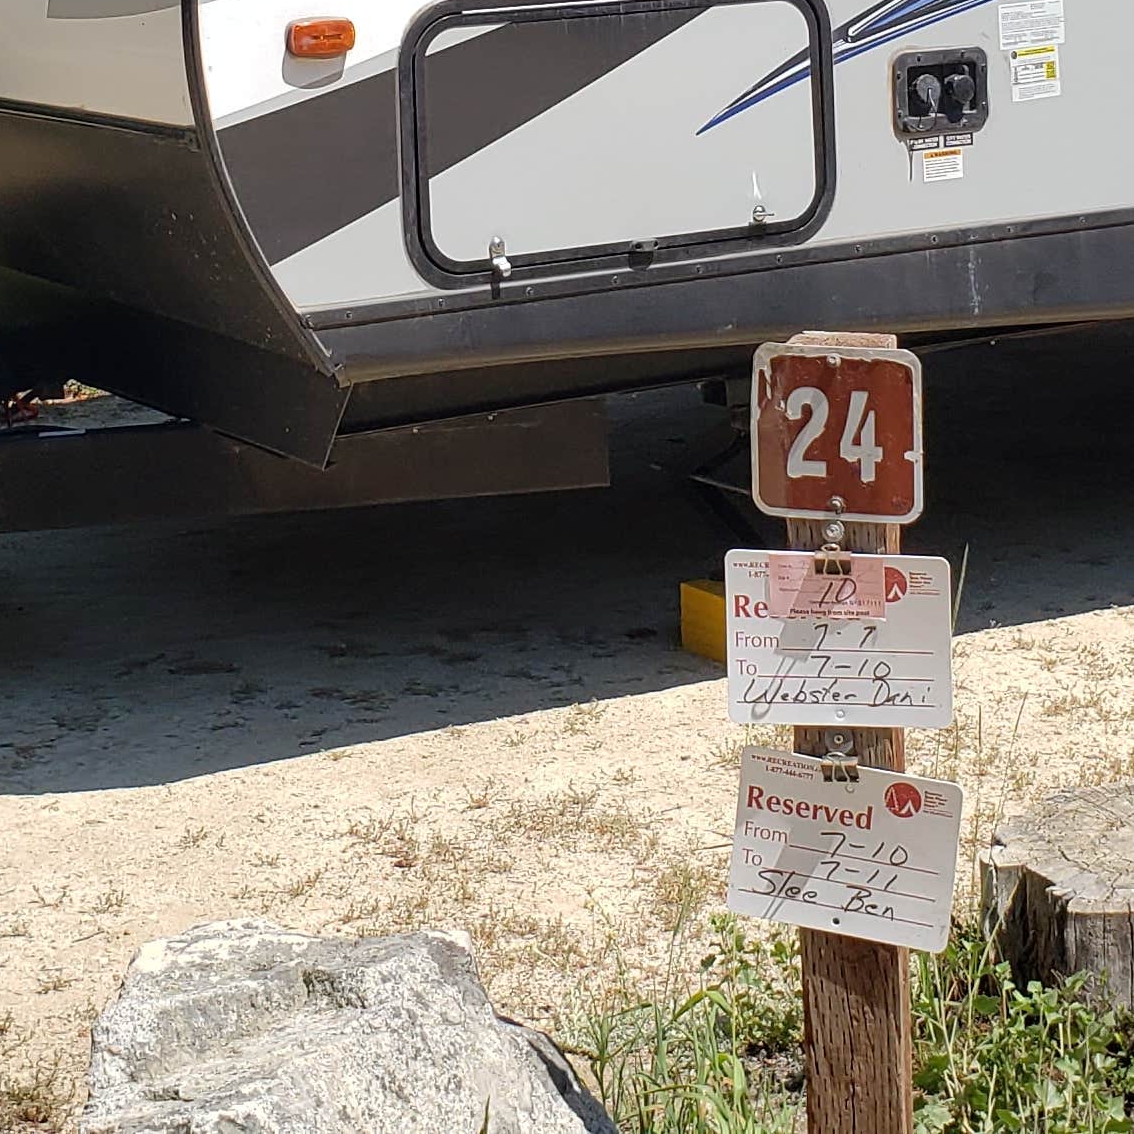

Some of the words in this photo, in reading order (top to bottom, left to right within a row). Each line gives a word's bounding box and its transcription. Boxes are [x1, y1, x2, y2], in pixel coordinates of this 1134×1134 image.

[785, 386, 883, 483] 24
[735, 631, 779, 648] From
[736, 659, 758, 676] To
[811, 656, 891, 679] 7-10
[743, 678, 857, 704] Webster
[746, 785, 874, 830] Reserved
[743, 821, 788, 844] From
[821, 832, 908, 866] 7-10
[742, 848, 763, 866] To
[820, 861, 898, 891] 7-11
[841, 885, 894, 920] Ben
